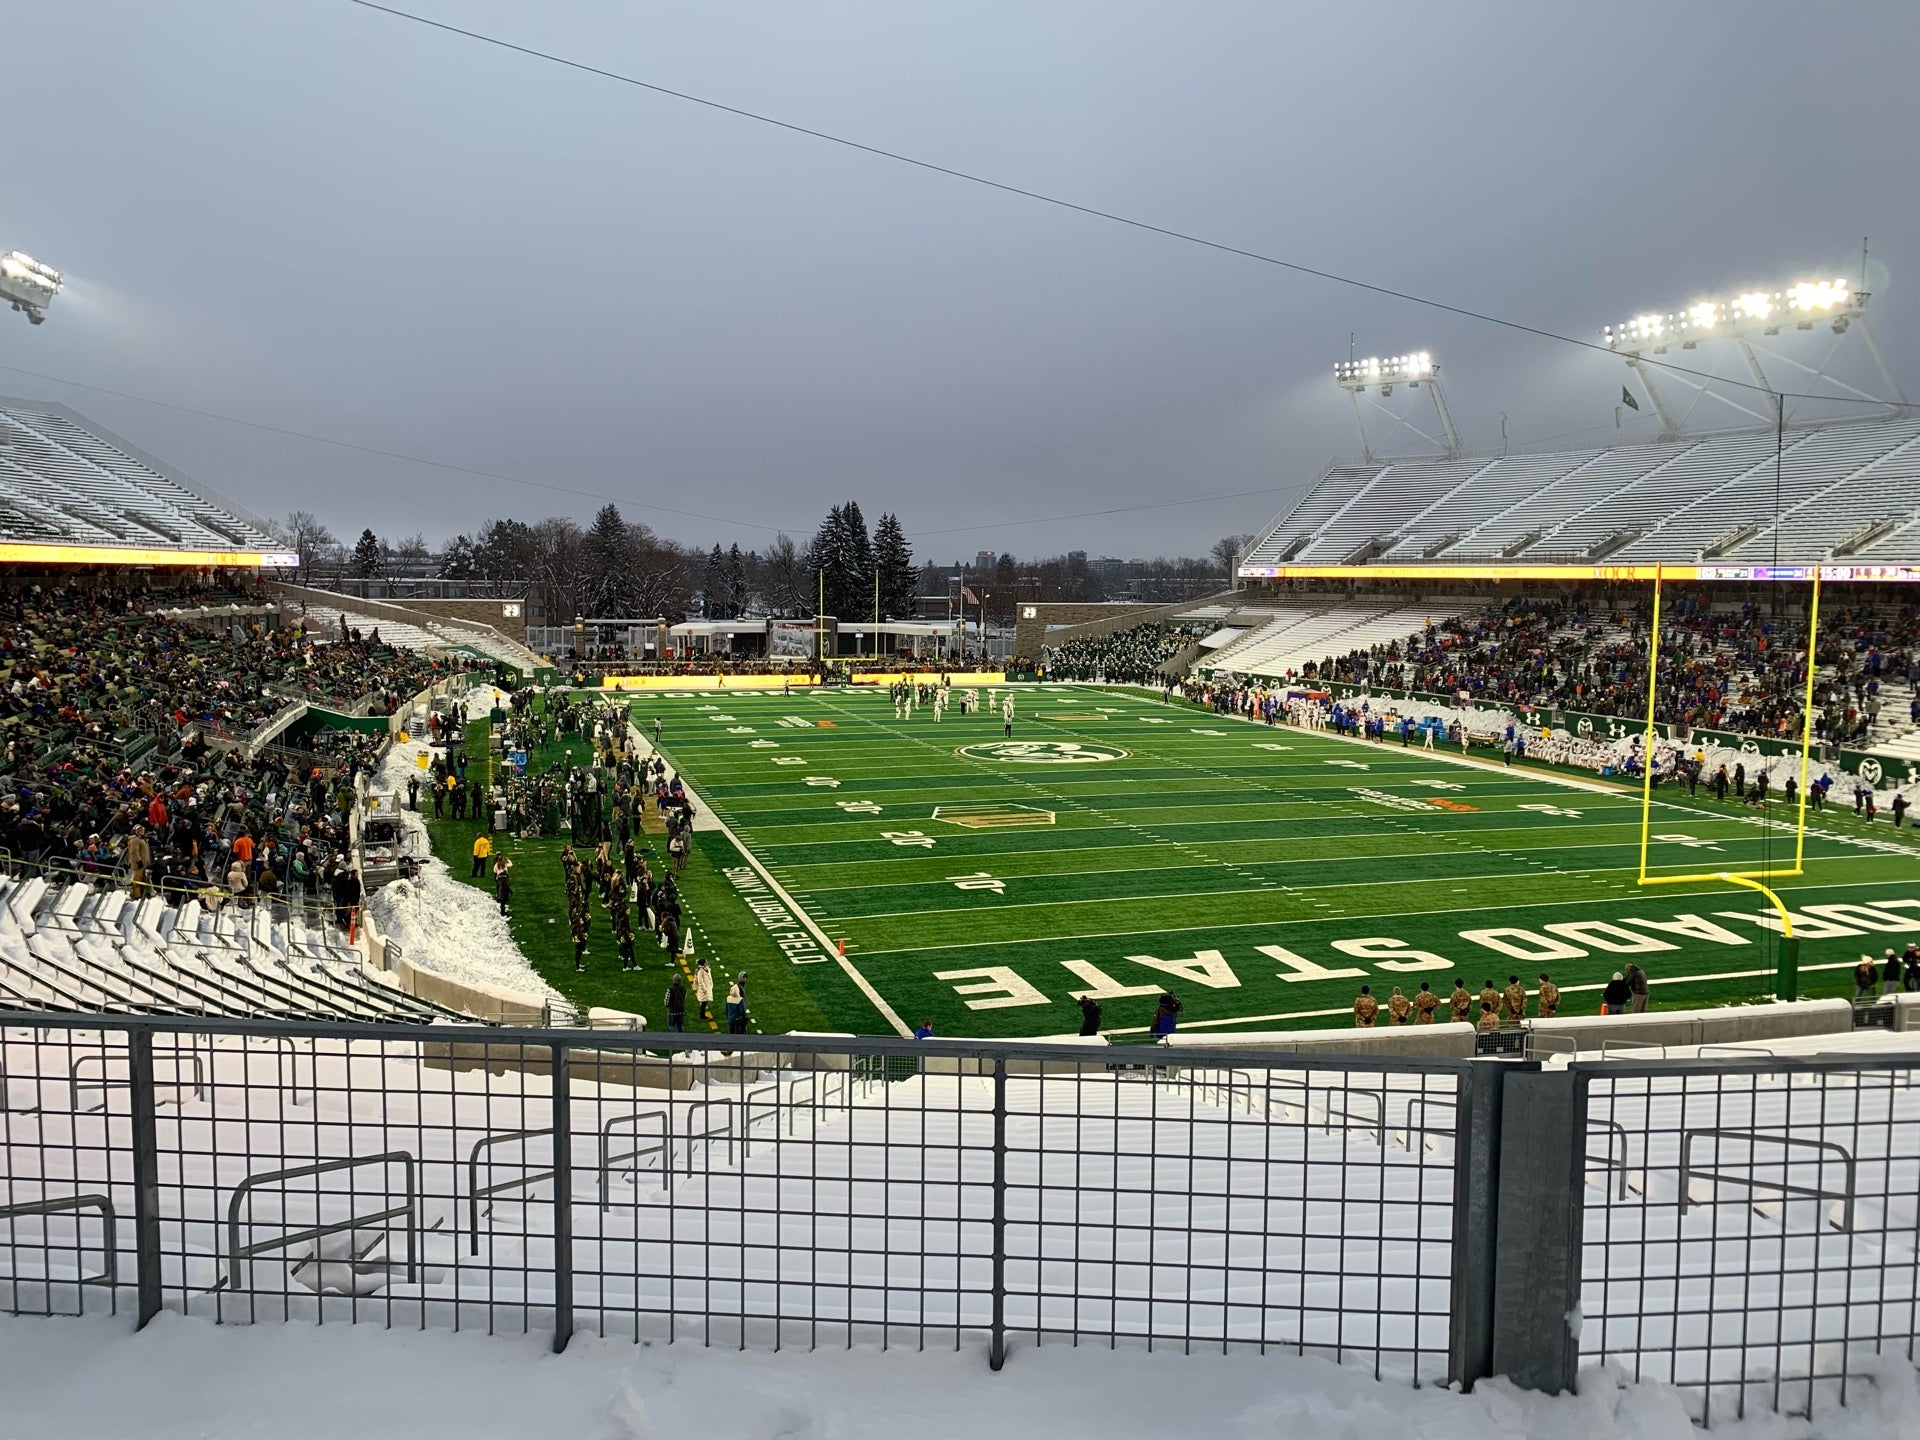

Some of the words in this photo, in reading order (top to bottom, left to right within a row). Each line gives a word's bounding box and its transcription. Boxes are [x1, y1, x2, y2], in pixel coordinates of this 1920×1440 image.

[836, 800, 884, 814] 30
[880, 830, 937, 847] 20
[722, 866, 769, 893] SONNY
[945, 872, 1007, 891] 10
[744, 895, 800, 930] LUBICK
[772, 931, 829, 965] FIELD
[932, 937, 1456, 1011] STATE
